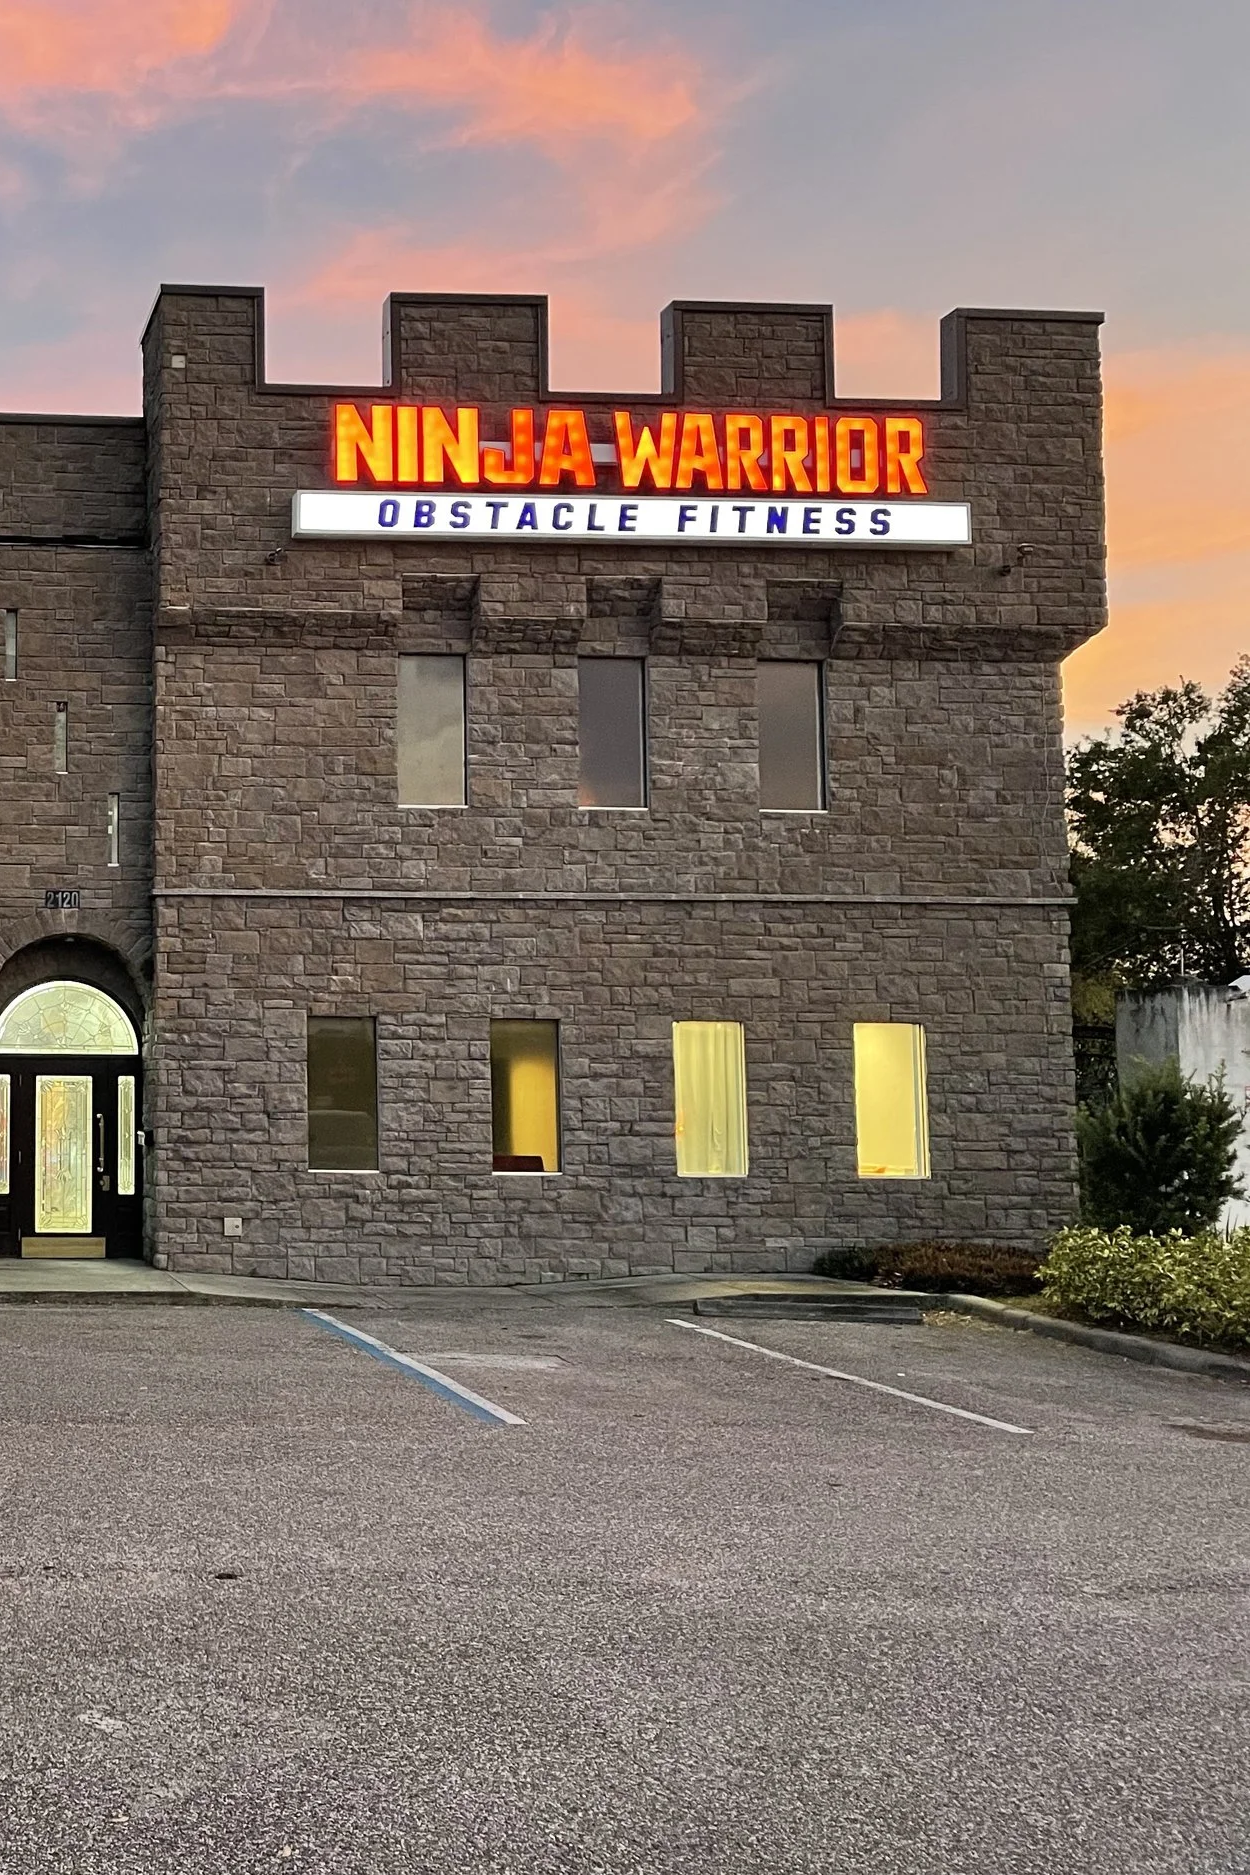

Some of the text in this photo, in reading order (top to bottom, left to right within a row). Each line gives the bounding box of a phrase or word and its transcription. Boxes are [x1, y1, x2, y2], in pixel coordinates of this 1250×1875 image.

[335, 404, 928, 494] NINJA WARRIOR
[378, 498, 892, 537] OBSTACLE FITNESS
[46, 891, 79, 908] 2120
